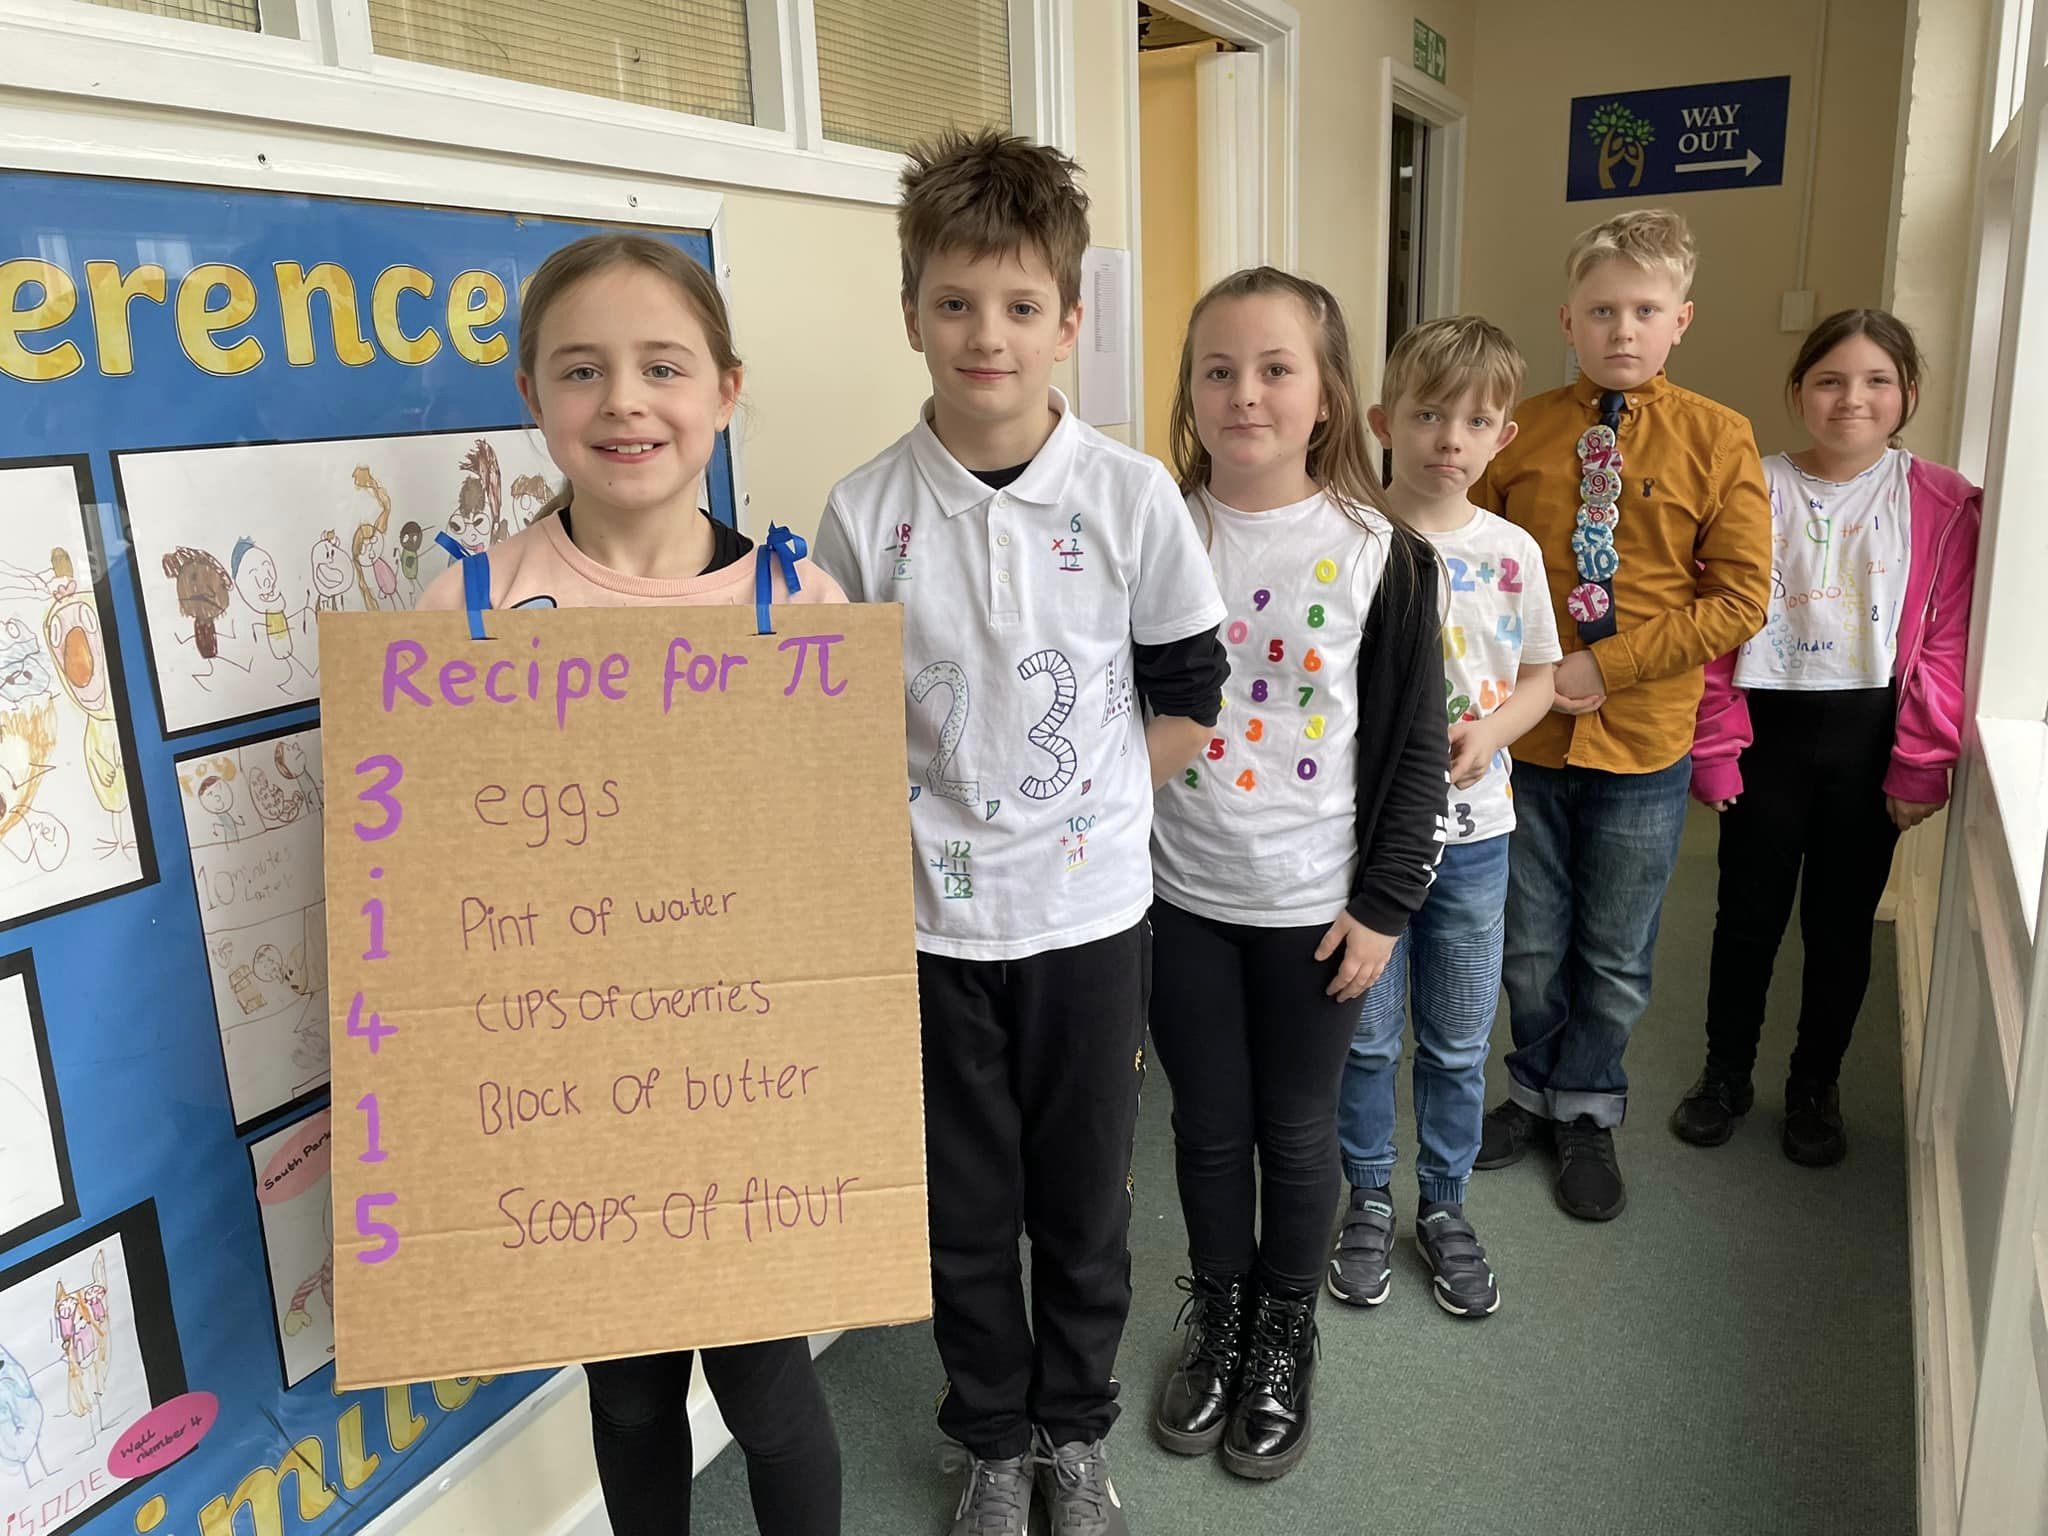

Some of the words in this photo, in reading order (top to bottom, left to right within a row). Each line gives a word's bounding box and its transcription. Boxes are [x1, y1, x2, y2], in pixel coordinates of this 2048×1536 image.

[1681, 104, 1741, 128] WAY
[1678, 129, 1740, 153] OUT
[0, 257, 536, 384] erence
[1592, 474, 1608, 494] 9
[1070, 513, 1082, 533] 6
[1315, 559, 1337, 584] 0
[1584, 549, 1616, 577] 10
[1253, 589, 1271, 612] 9
[1307, 604, 1325, 629] 8
[1228, 621, 1248, 645] 0
[1268, 639, 1284, 663] 5
[1303, 648, 1322, 673] 6
[382, 637, 630, 731] Recipe
[664, 637, 748, 715] for
[778, 634, 848, 697] π
[1252, 679, 1269, 703] 8
[1298, 687, 1314, 708] 7
[1245, 718, 1264, 742] 3
[1207, 738, 1225, 761] 5
[1184, 768, 1198, 789] 2
[1235, 768, 1256, 792] 4
[1297, 757, 1317, 781] 0
[353, 754, 404, 842] 3
[474, 779, 621, 847] eggs
[1455, 803, 1475, 837] 3
[361, 898, 390, 960] 1
[460, 897, 539, 952] Pint
[637, 887, 737, 924] water
[347, 991, 399, 1054] 4
[631, 979, 773, 1022] cherries
[356, 1092, 389, 1163] 1
[479, 1080, 582, 1135] Block
[685, 1058, 820, 1112] butter
[264, 1157, 303, 1191] South
[355, 1192, 399, 1264] 5
[740, 1176, 861, 1243] flour
[120, 1427, 157, 1458] Wall
[136, 1425, 187, 1464] number
[190, 1415, 203, 1427] 4
